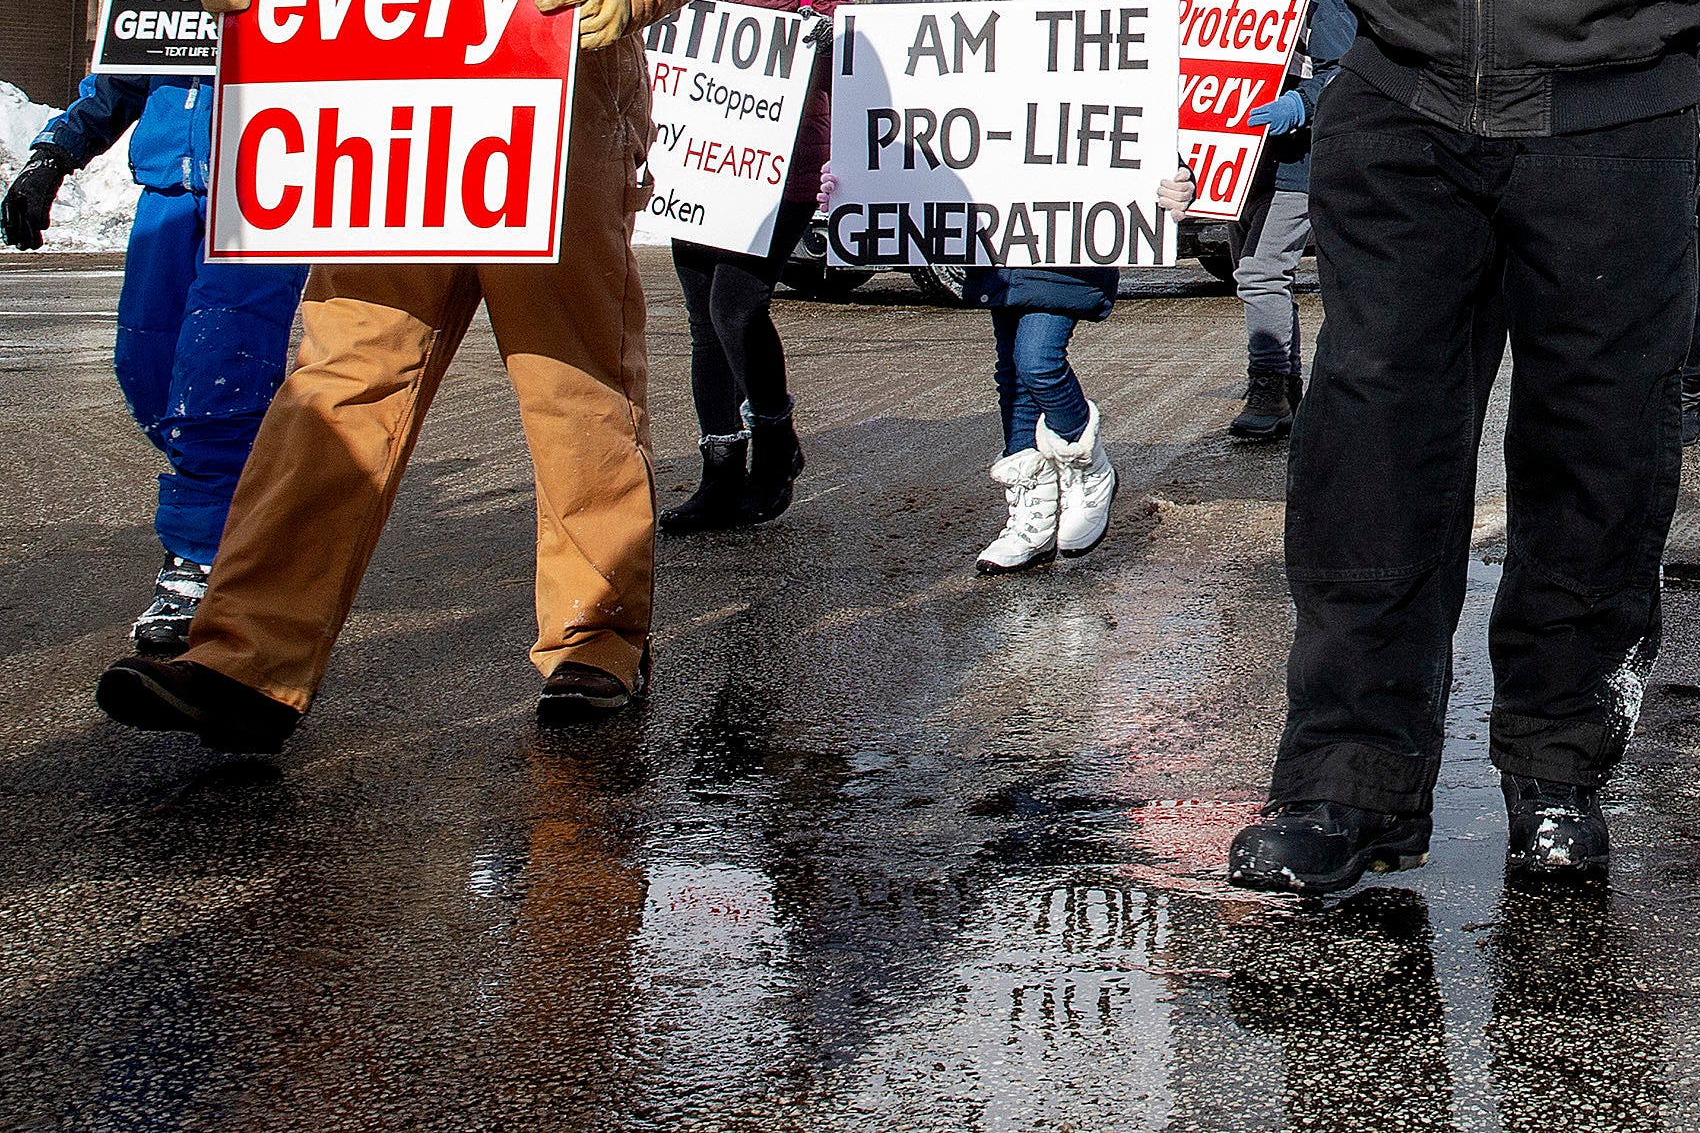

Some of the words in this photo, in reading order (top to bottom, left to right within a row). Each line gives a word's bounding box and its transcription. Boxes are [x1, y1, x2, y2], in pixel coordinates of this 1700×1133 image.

[164, 46, 188, 58] TEXT
[188, 46, 209, 58] LIFE
[841, 14, 857, 77] I
[903, 9, 1001, 77] AM
[1034, 7, 1149, 73] THE
[688, 71, 785, 123] Stopped
[234, 105, 537, 231] Child
[682, 136, 785, 186] HEARTS
[866, 101, 1144, 171] PRO-LIFE
[827, 199, 1167, 267] GENERATION
